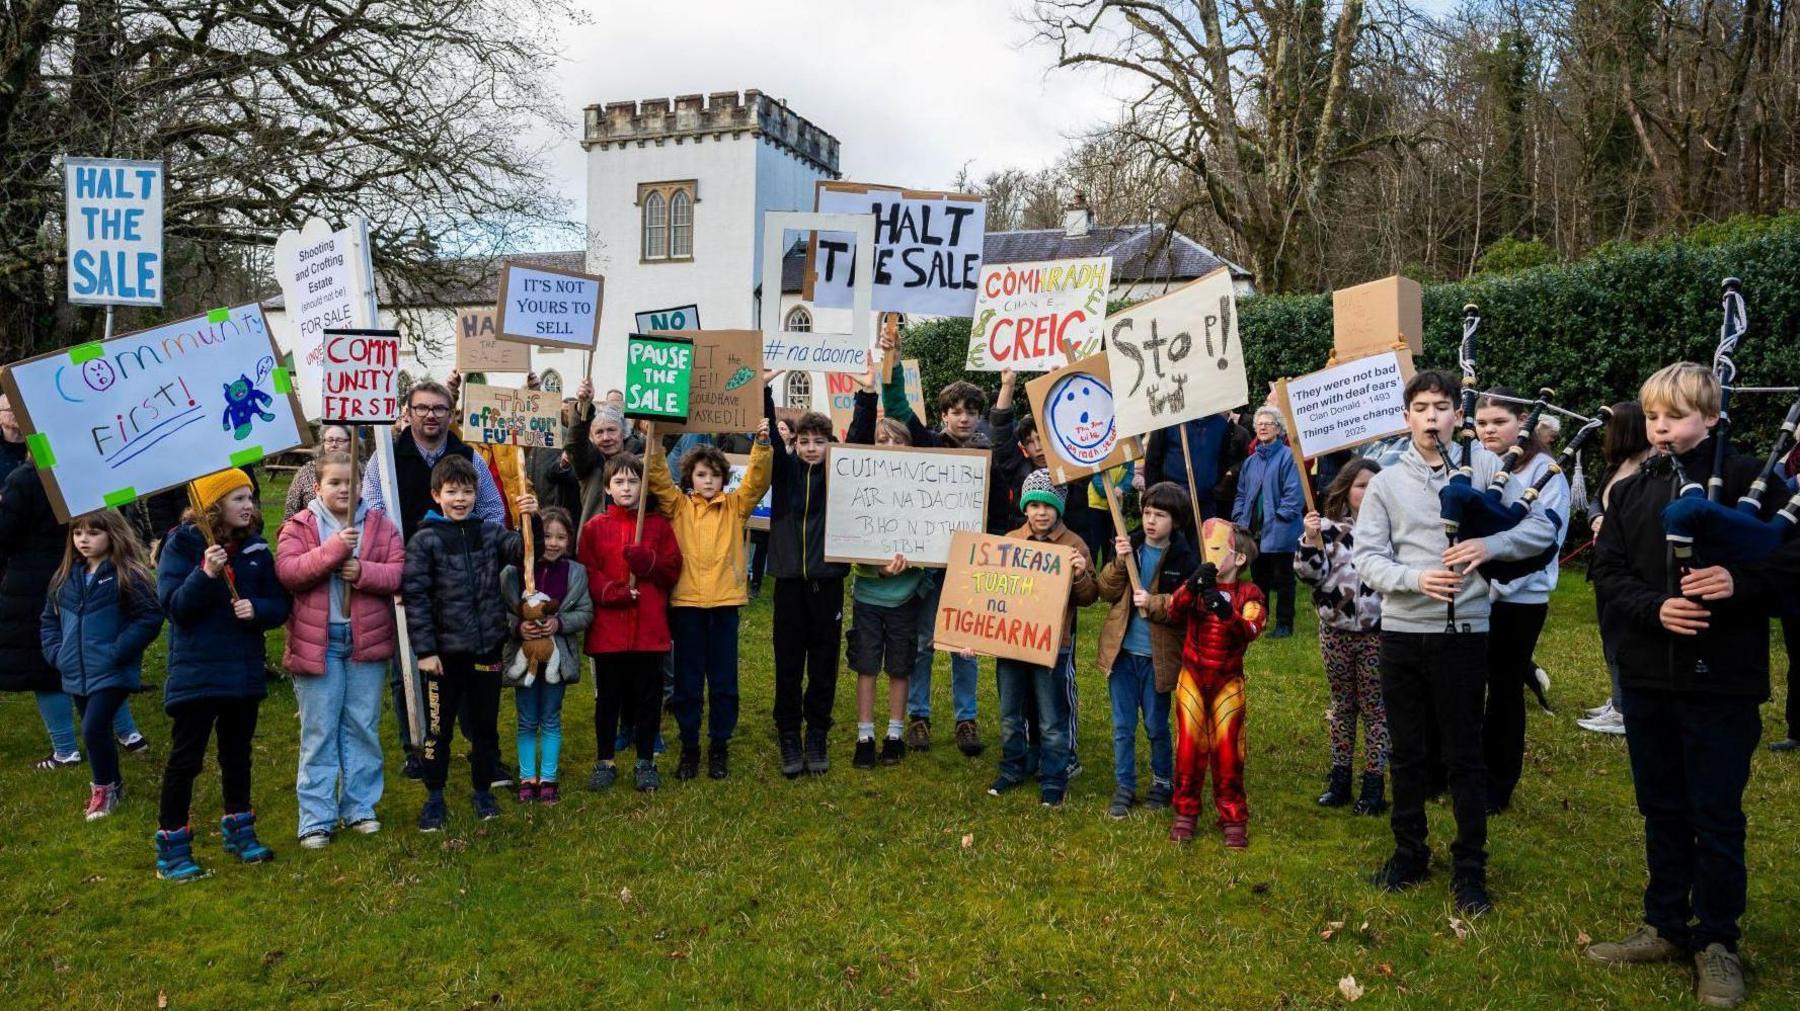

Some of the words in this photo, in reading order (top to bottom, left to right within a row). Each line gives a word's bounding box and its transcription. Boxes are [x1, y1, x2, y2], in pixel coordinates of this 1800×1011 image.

[76, 167, 156, 199] HALT
[81, 207, 144, 241] THE
[871, 202, 974, 246] HALT
[299, 239, 335, 262] Shooting
[73, 249, 158, 298] SALE
[295, 265, 310, 282] and
[311, 253, 344, 277] Crofting
[902, 247, 979, 290] SALE
[308, 275, 333, 294] Estate
[524, 278, 551, 292] IT'S
[556, 281, 585, 294] NOT
[301, 294, 321, 314] (should
[322, 290, 333, 305] not
[334, 286, 347, 299] be)
[516, 299, 568, 314] YOURS
[571, 301, 591, 315] TO
[301, 311, 323, 337] FOR
[324, 303, 352, 328] SALE
[536, 321, 573, 335] SELL
[651, 311, 686, 330] NO
[480, 340, 497, 349] THE
[989, 310, 1086, 362] CREIC
[470, 350, 512, 363] SALE
[629, 343, 689, 369] PAUSE
[812, 340, 865, 366] daoine
[327, 369, 394, 394] UNITY
[643, 368, 679, 384] THE
[828, 372, 853, 394] NO
[1323, 377, 1351, 392] were
[1353, 369, 1372, 383] not
[1375, 363, 1396, 376] bad
[494, 389, 541, 412] This
[627, 384, 680, 413] SALE
[1296, 403, 1319, 416] men
[1320, 393, 1344, 408] with
[1345, 382, 1371, 400] deaf
[1309, 410, 1329, 422] Clan
[1330, 400, 1361, 416] Donald
[1369, 391, 1391, 404] 1493
[1302, 423, 1335, 440] Things
[1337, 415, 1361, 428] have
[1344, 424, 1367, 438] 2025
[851, 487, 885, 507] AIR
[892, 490, 914, 508] NA
[969, 542, 991, 567] IS
[997, 543, 1061, 576] TREASA
[972, 571, 1034, 595] TUATH
[987, 598, 1008, 614] na
[942, 607, 1053, 652] TIGHEARNA
